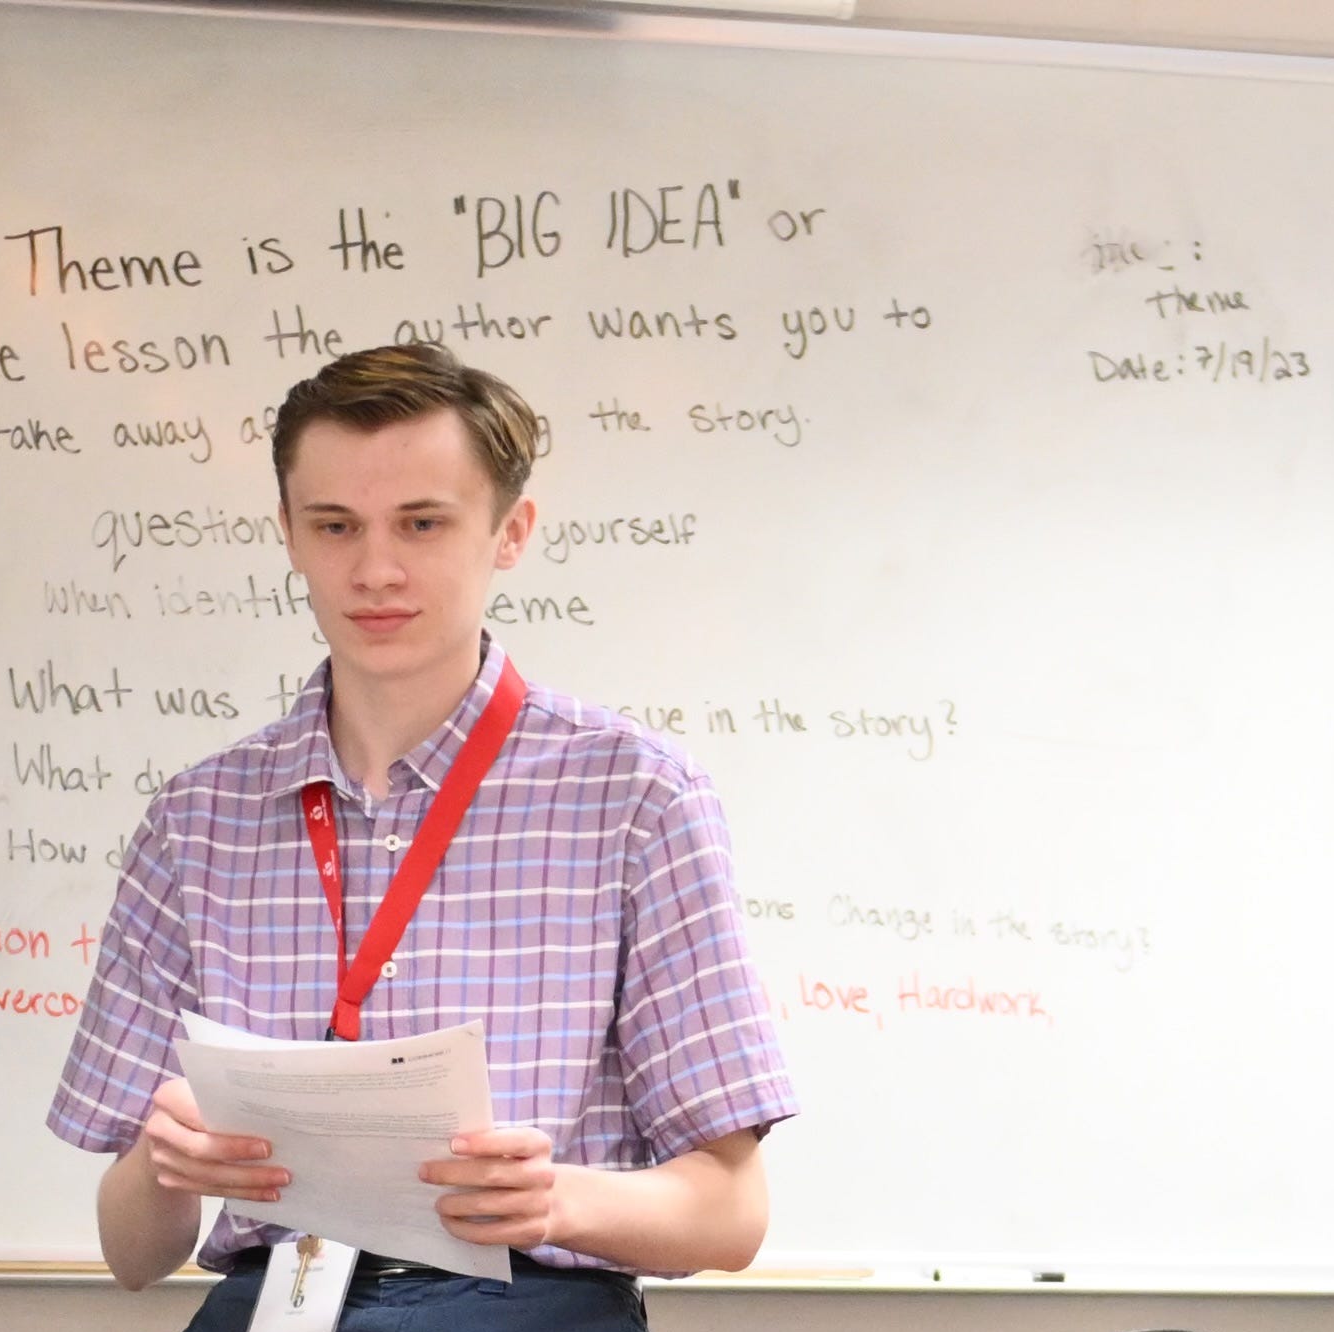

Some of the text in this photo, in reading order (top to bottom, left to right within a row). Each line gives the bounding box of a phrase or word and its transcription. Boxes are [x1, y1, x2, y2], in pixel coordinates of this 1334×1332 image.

[4, 225, 202, 296] Theme
[246, 237, 295, 275] is
[767, 208, 826, 242] or
[60, 321, 231, 374] lesson
[263, 303, 347, 360] the
[587, 304, 738, 341] wants
[781, 306, 855, 361] you
[883, 298, 932, 330] to
[113, 417, 212, 464] away
[588, 398, 652, 432] the
[541, 513, 697, 565] yourself
[7, 659, 133, 716] What
[154, 687, 240, 720] was
[705, 700, 738, 735] in
[754, 698, 808, 733] the
[12, 741, 113, 793] What
[7, 828, 88, 864] How
